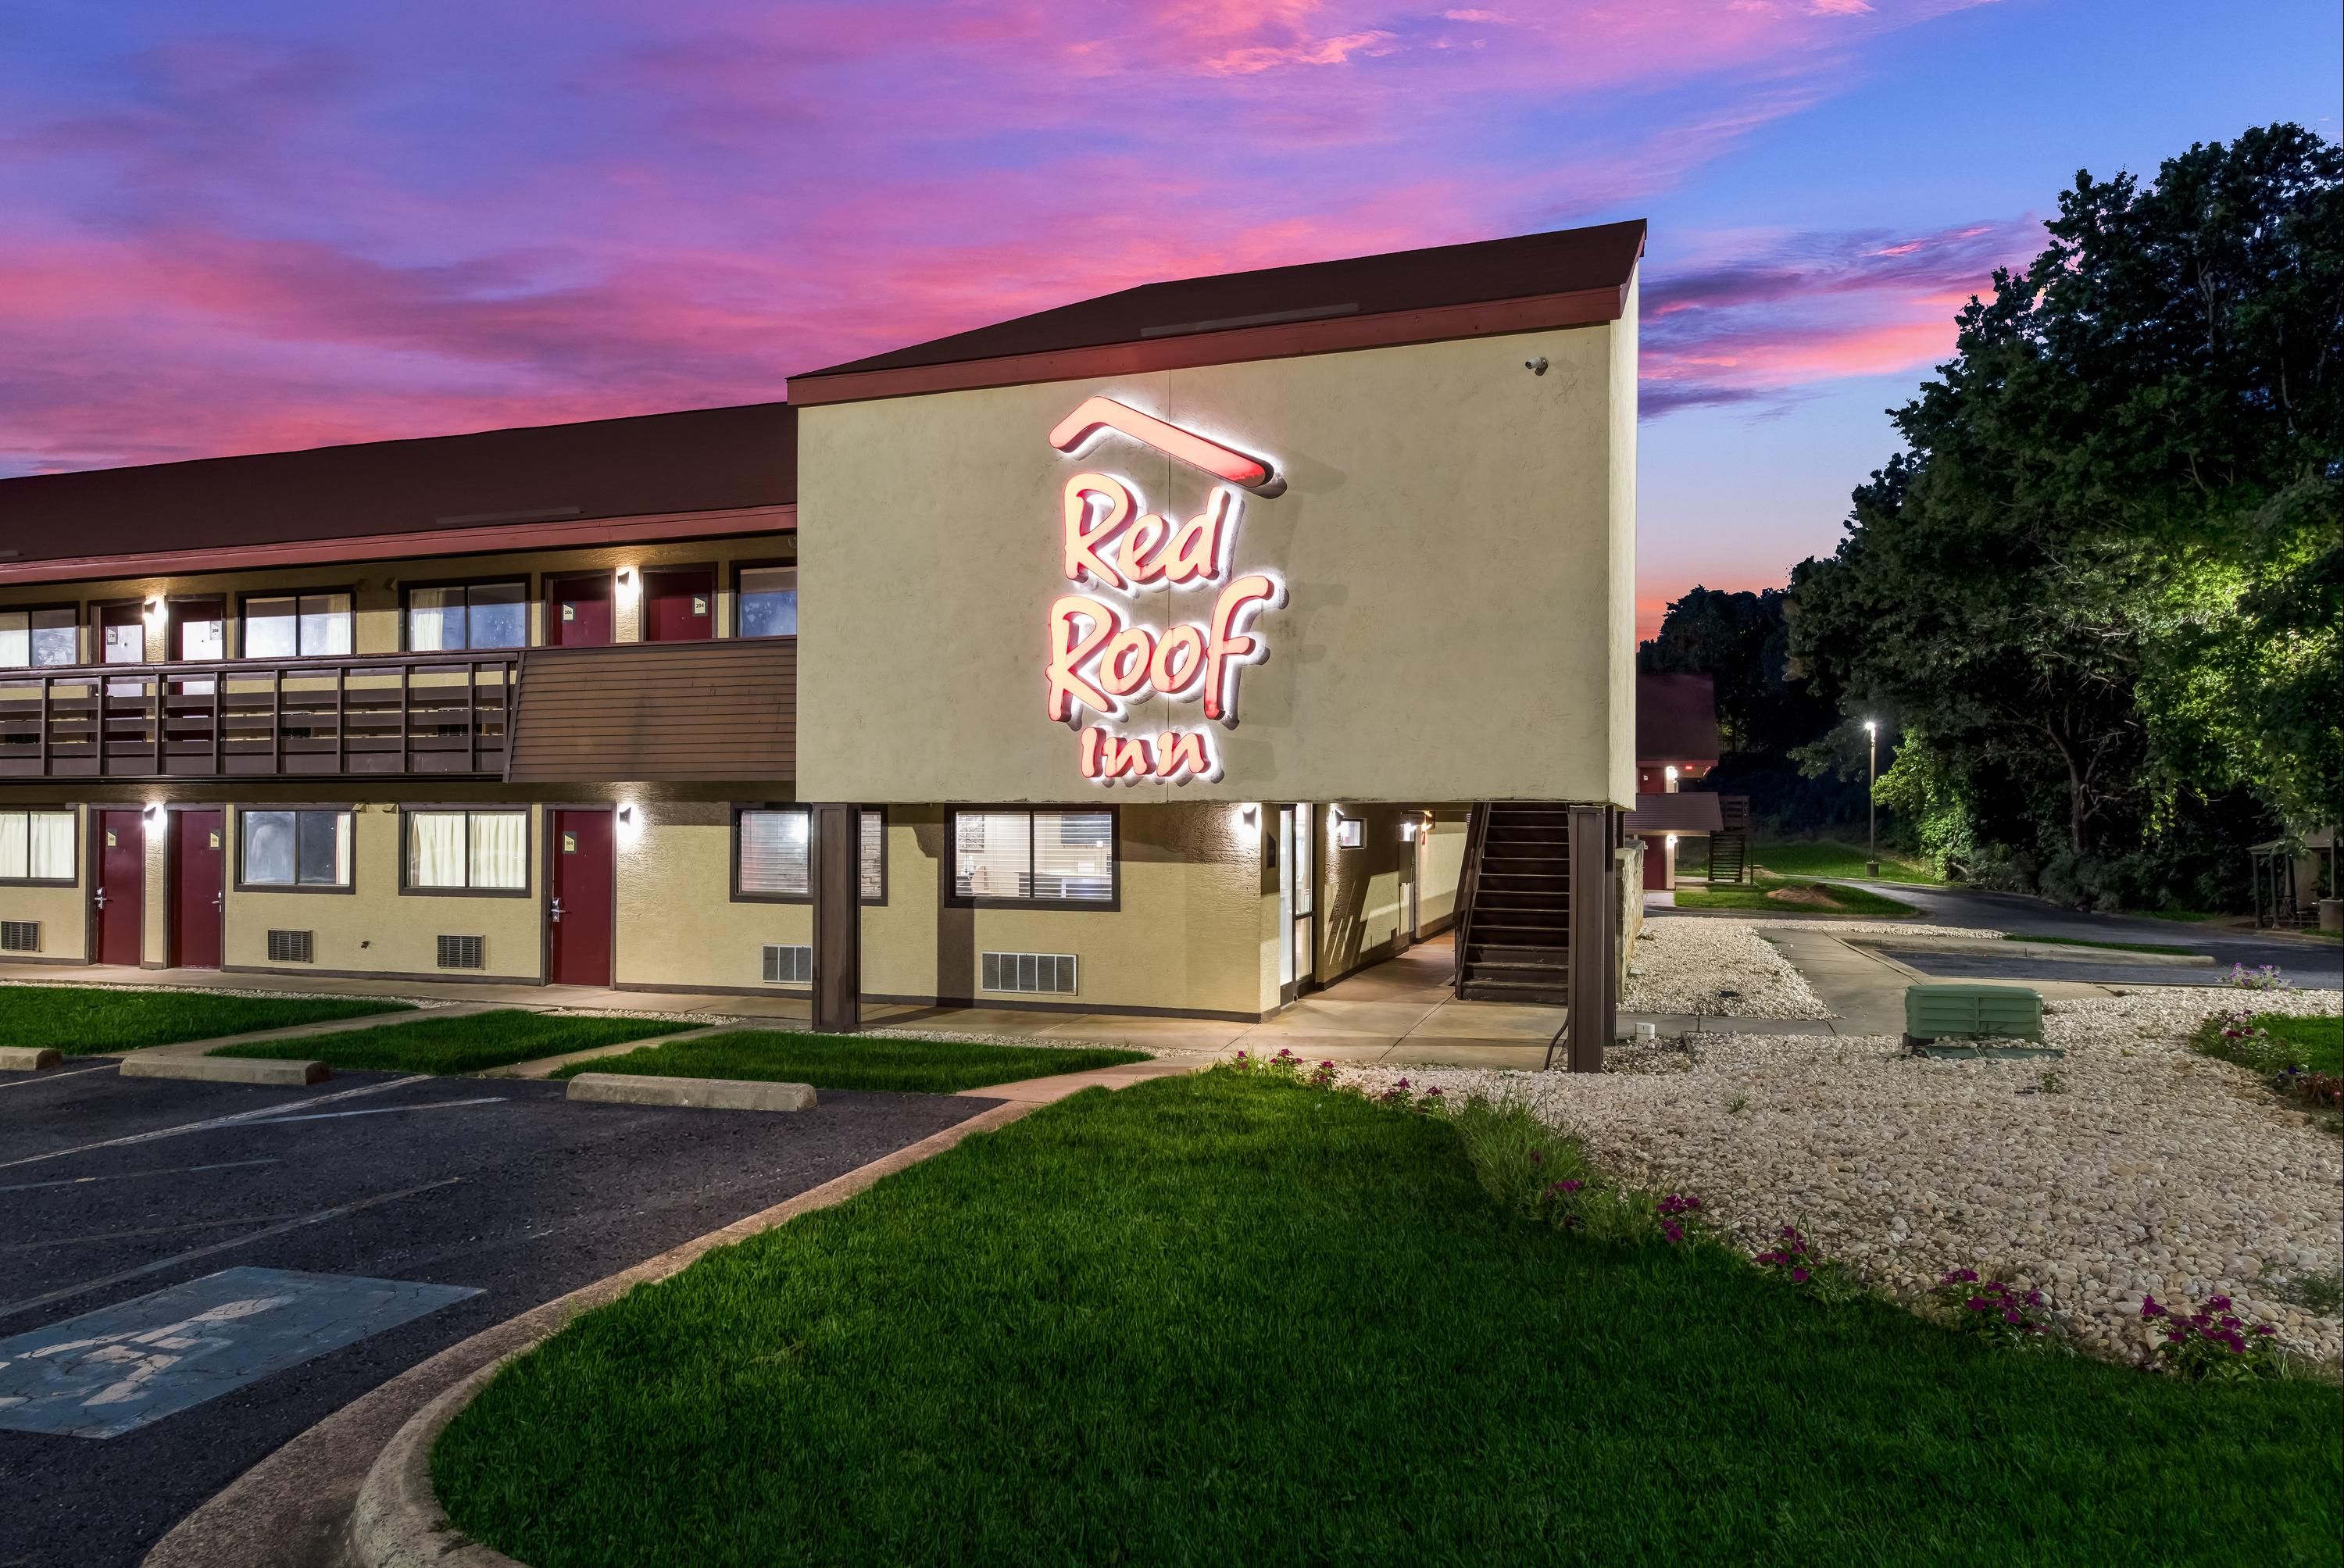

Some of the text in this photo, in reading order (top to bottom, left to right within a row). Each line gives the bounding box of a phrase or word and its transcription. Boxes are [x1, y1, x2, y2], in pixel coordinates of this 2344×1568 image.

[1063, 472, 1230, 589] Red
[1045, 575, 1274, 721] Roof
[1080, 727, 1211, 777] Inn
